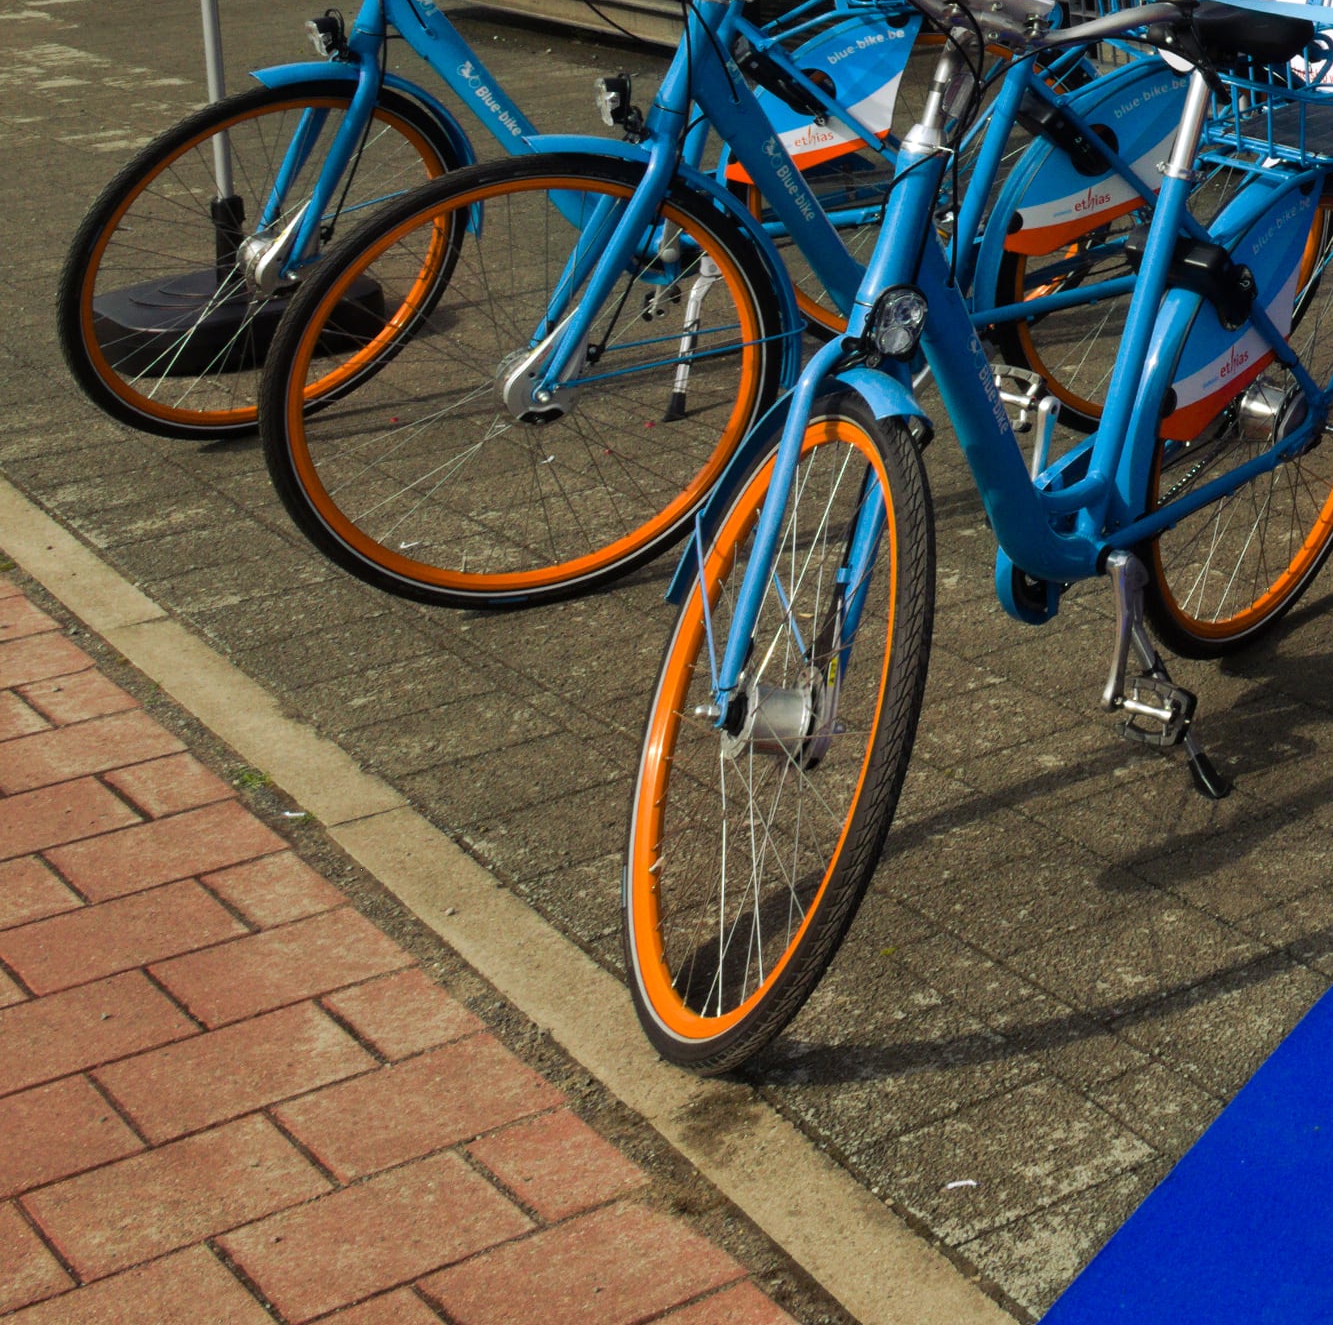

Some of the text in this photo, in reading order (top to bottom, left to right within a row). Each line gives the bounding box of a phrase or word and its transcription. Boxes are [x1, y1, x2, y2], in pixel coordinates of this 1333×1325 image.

[827, 29, 905, 65] blue-bike.be
[475, 86, 522, 136] Blue-bike
[1113, 78, 1187, 119] blue-bike.be
[794, 125, 834, 147] ethias
[776, 164, 816, 221] Blue-bike
[1074, 187, 1111, 212] ethias
[1252, 196, 1312, 255] blue-bike.be
[1219, 344, 1249, 378] ethias
[979, 363, 1009, 435] Blue-bike
